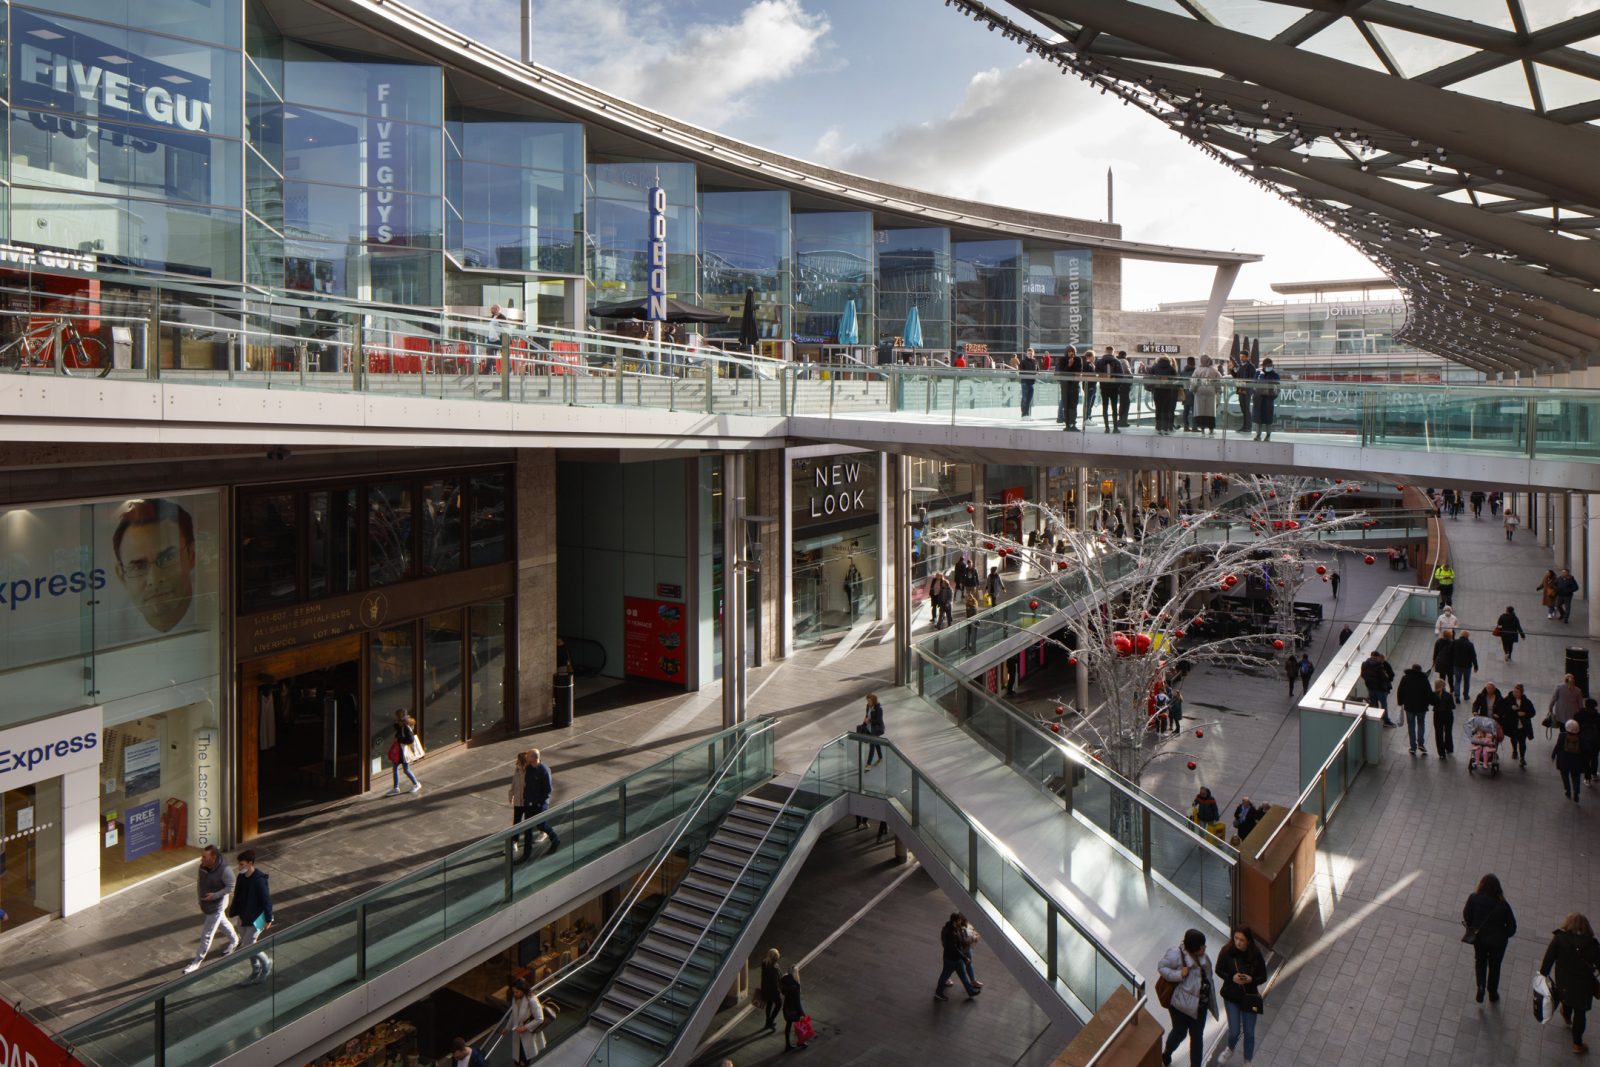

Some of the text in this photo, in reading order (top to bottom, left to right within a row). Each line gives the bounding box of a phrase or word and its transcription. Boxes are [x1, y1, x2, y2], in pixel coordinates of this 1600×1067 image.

[21, 44, 130, 111] FIVE
[376, 84, 394, 244] FIVE GUYS
[38, 250, 97, 273] GUYS
[650, 188, 667, 321] ODEON
[1068, 256, 1083, 347] wagamama
[1325, 303, 1402, 320] John Lewis
[1280, 388, 1321, 402] MORE
[815, 463, 860, 488] NEW
[811, 489, 865, 518] LOOK
[198, 733, 211, 844] The Laser Clinic
[129, 808, 156, 825] FREE
